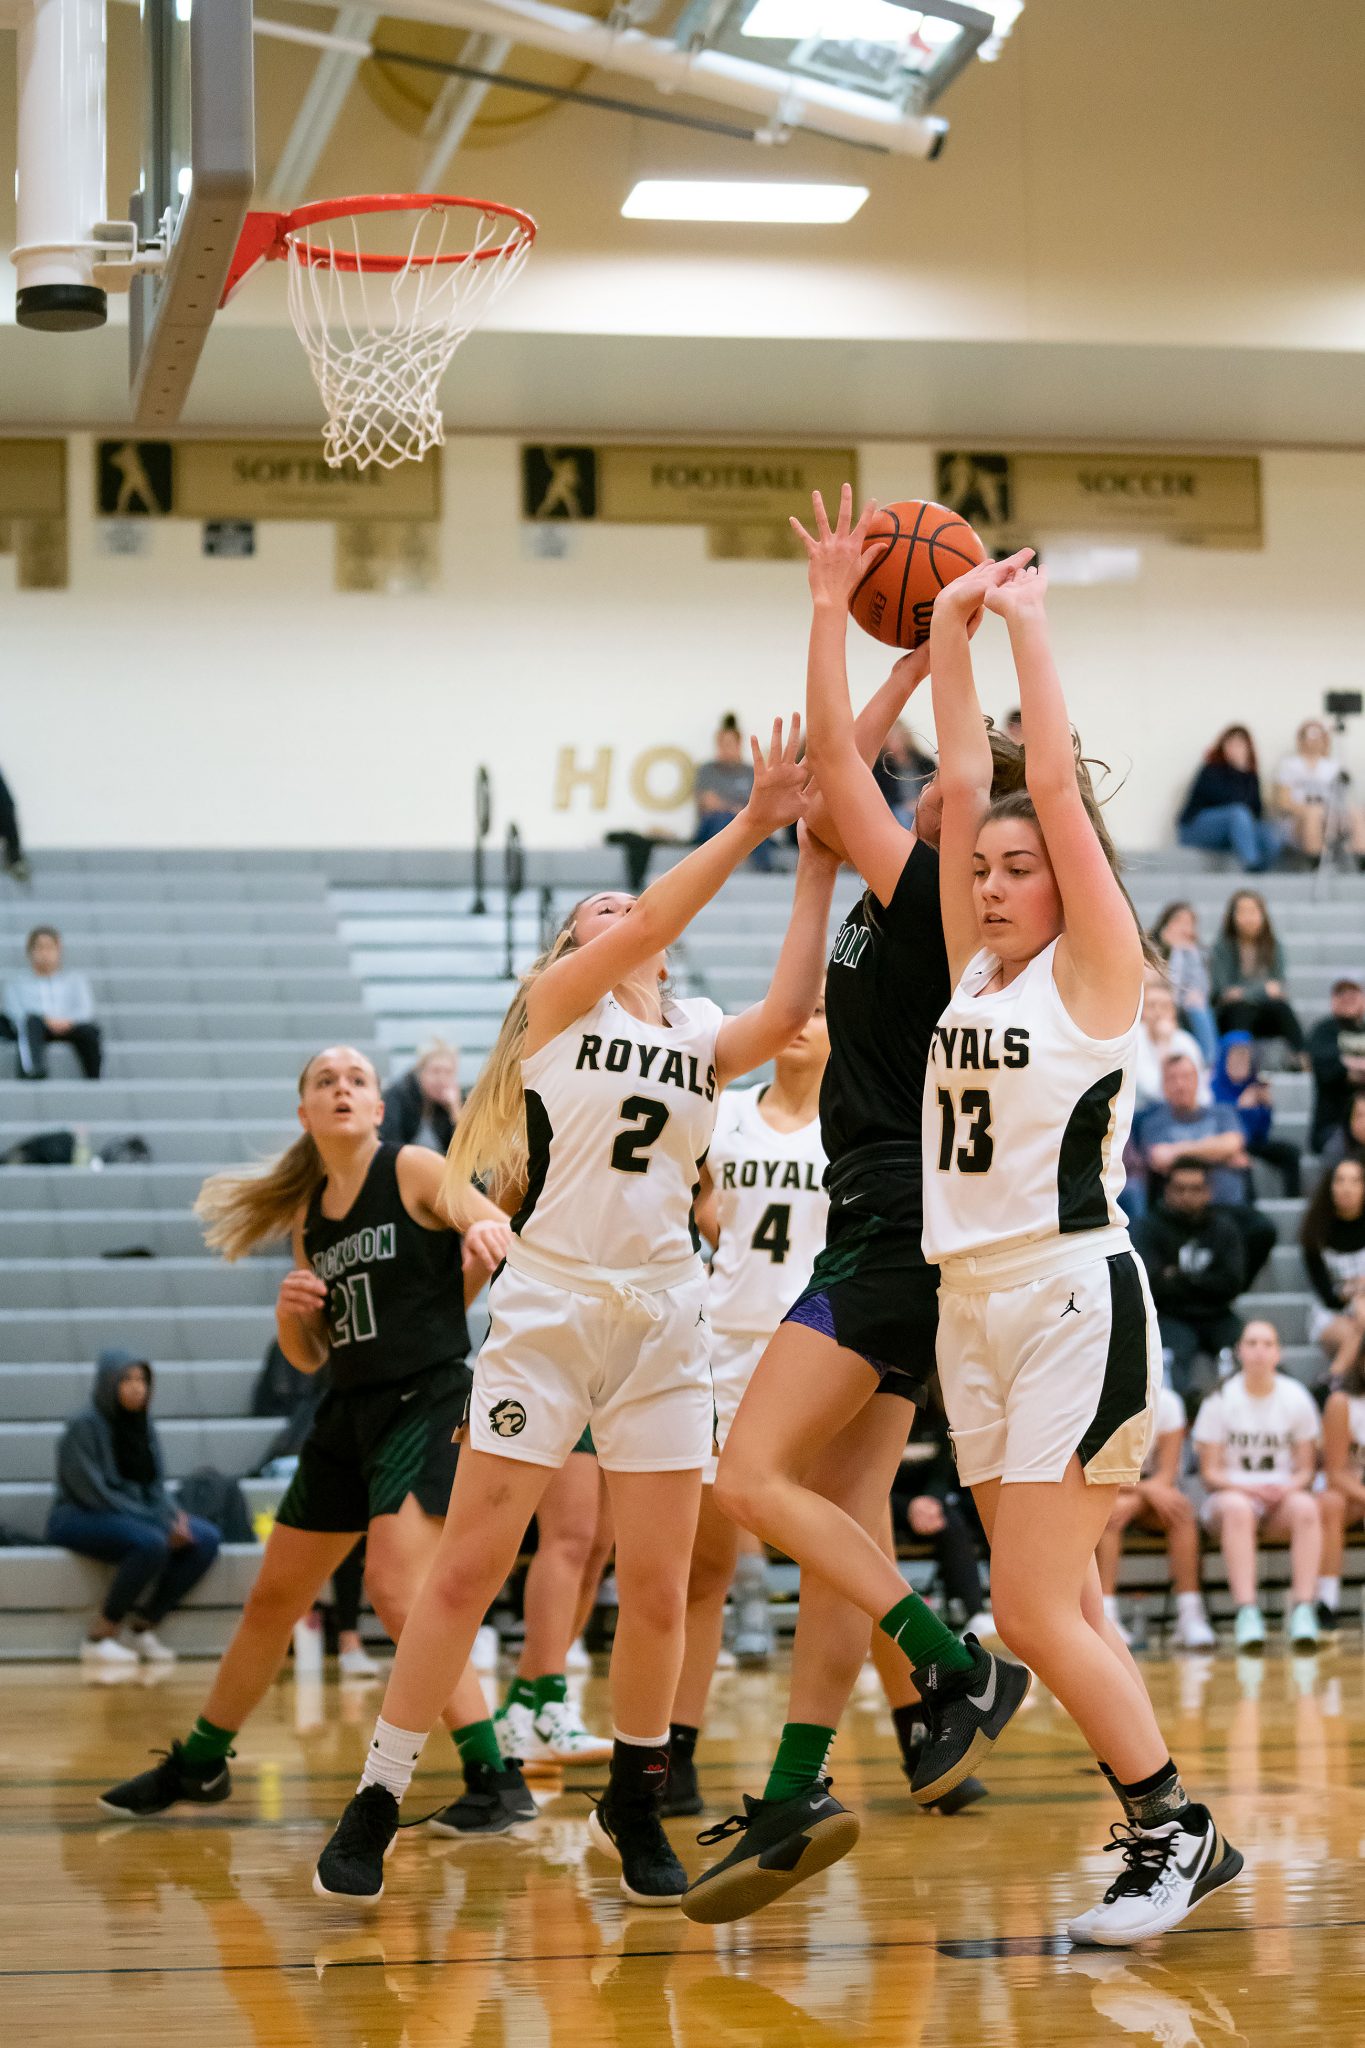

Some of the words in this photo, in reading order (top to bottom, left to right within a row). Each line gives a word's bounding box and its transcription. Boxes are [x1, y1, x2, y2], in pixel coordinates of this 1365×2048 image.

[651, 462, 805, 490] FOOTBALL
[1076, 469, 1196, 497] SOCCER
[575, 1034, 717, 1103] ROYALS
[609, 1092, 673, 1175] 2
[935, 1083, 995, 1177] 13
[722, 1159, 830, 1194] ROYAL
[750, 1201, 793, 1265] 4
[328, 1272, 377, 1348] 21
